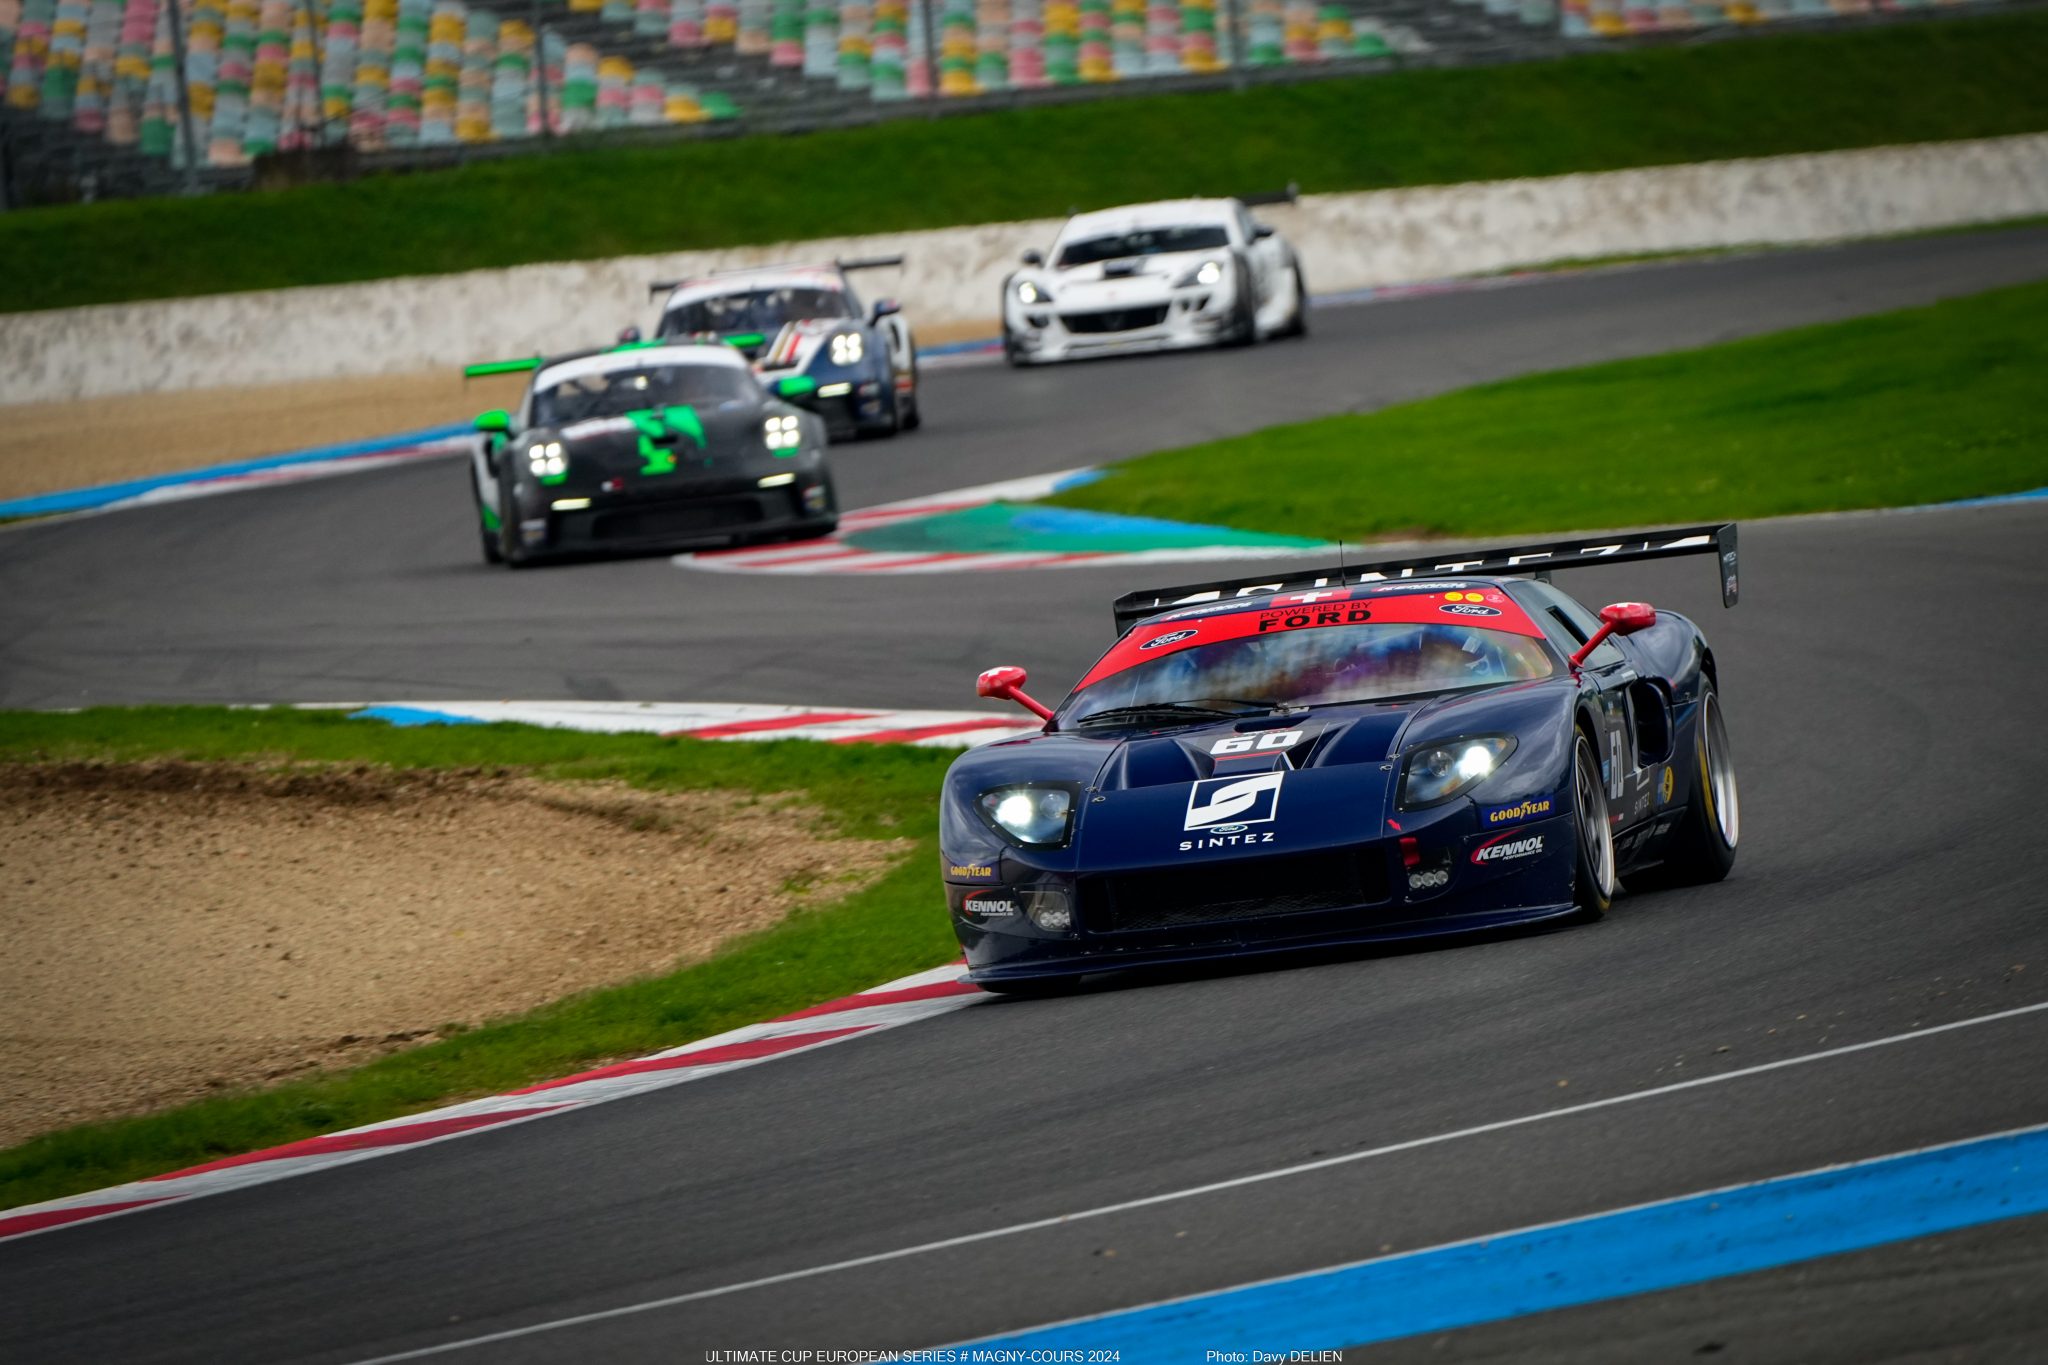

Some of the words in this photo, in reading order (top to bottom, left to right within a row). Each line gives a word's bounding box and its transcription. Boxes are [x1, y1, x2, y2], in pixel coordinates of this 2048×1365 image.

[1260, 603, 1345, 619] POWERED
[1350, 601, 1373, 610] BY
[1258, 610, 1372, 632] FORD
[1210, 731, 1303, 755] 60
[1490, 801, 1550, 822] GOODYEAR
[1179, 832, 1274, 851] SINTEZ
[1476, 836, 1543, 861] KENNOL
[950, 864, 991, 878] GOODYEAR
[965, 900, 1014, 912] KENNOL
